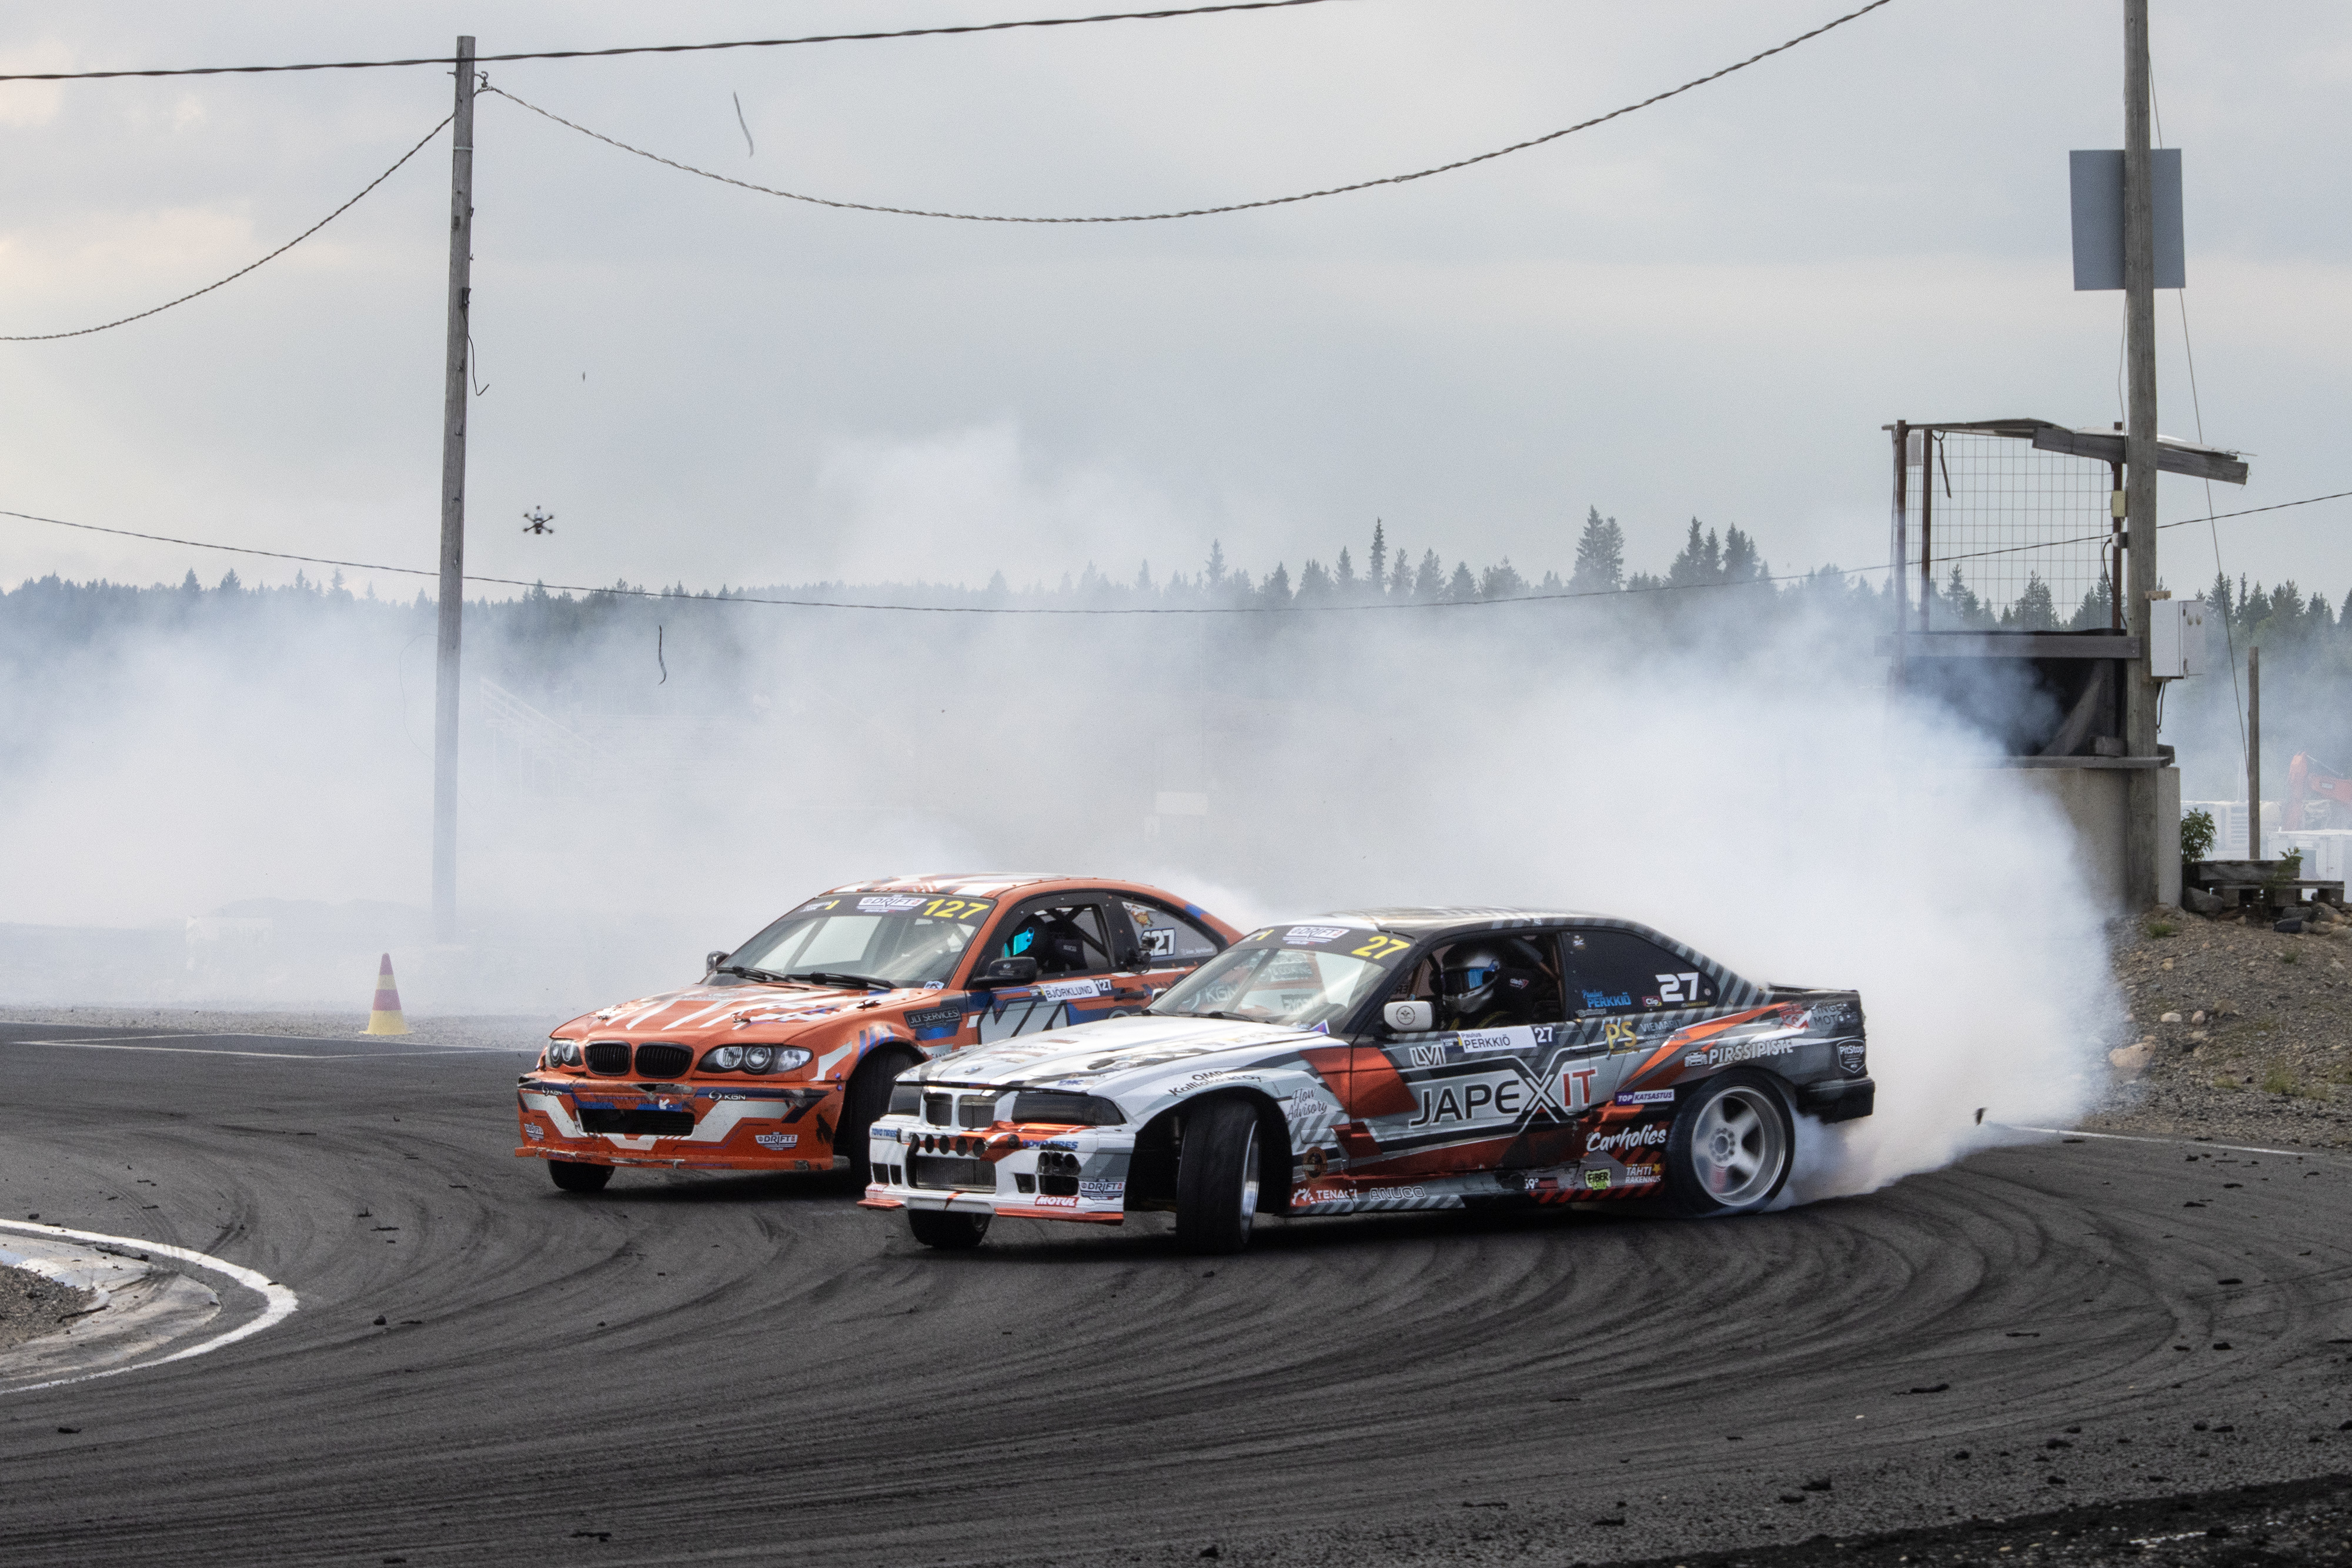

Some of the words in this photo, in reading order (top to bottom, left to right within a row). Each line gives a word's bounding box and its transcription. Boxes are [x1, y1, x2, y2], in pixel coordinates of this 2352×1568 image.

[873, 897, 911, 908] DRIFT
[923, 899, 990, 919] 127
[1351, 935, 1411, 959] 27
[1045, 984, 1093, 998] BJÖRKLUND
[1095, 979, 1112, 991] 127
[1655, 972, 1699, 1002] 27
[1587, 992, 1632, 1008] PERKKIÖ
[923, 1007, 958, 1022] SERVICES
[1465, 1034, 1511, 1049] PERKKIÖ
[1535, 1027, 1553, 1043] 27
[1605, 1021, 1637, 1049] PS
[1709, 1038, 1794, 1065] PIRSSIPISTE
[1839, 1045, 1865, 1056] PitStop
[1292, 1088, 1317, 1105] Flow
[1618, 1094, 1633, 1102] TOP
[1634, 1091, 1673, 1101] KATSASTUS
[1287, 1100, 1328, 1119] Advisory
[764, 1135, 791, 1146] DRIFT
[1586, 1124, 1667, 1152] Carholics
[1626, 1164, 1652, 1176] TÄHTI
[1088, 1182, 1119, 1194] DRIFT
[1037, 1196, 1076, 1207] MOTUL
